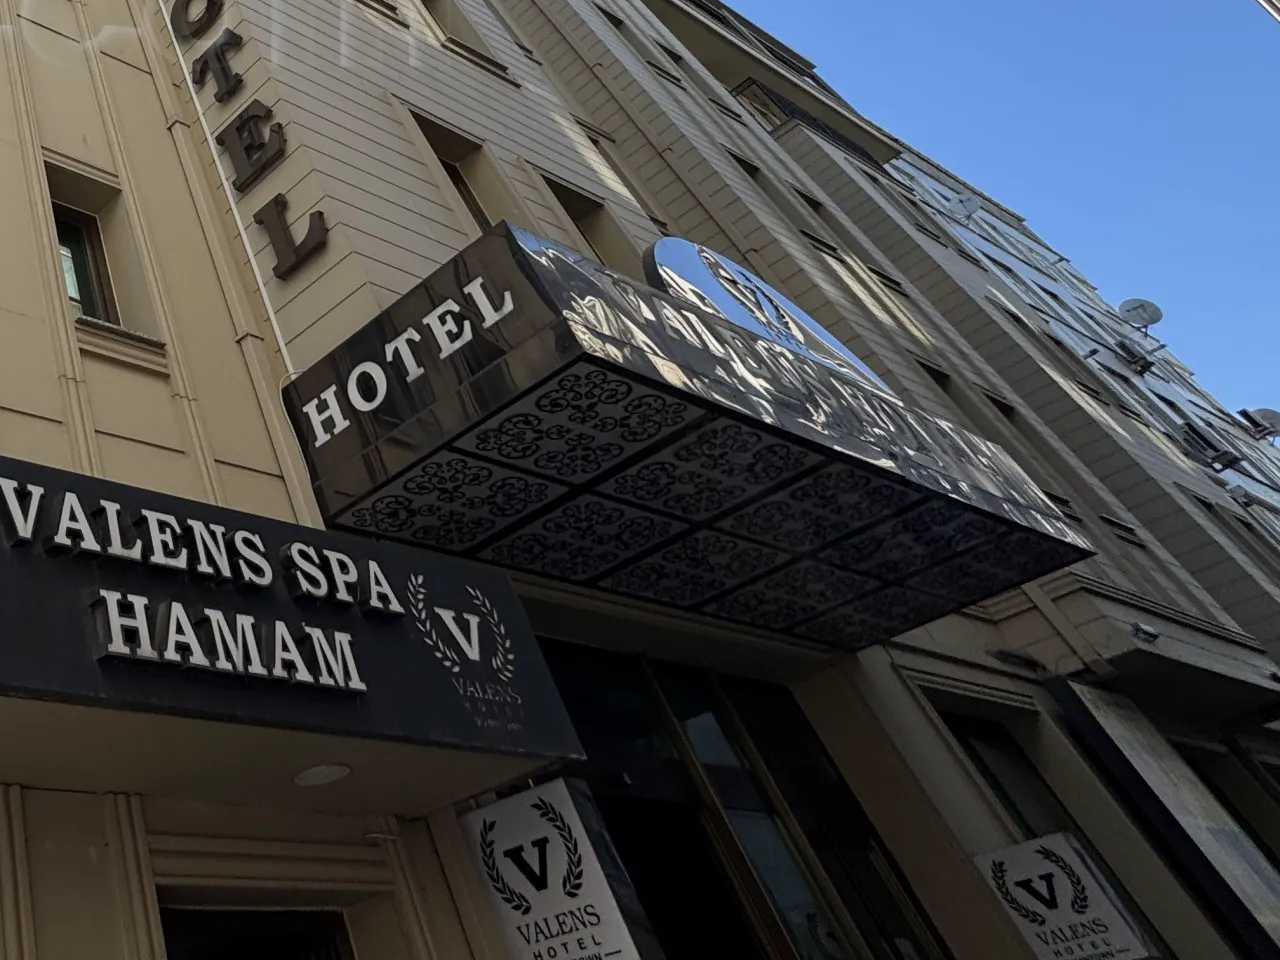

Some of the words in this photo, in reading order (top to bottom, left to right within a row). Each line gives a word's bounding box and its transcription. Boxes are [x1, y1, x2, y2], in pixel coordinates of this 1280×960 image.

[302, 276, 515, 448] HOTEL
[291, 542, 406, 613] SPA
[99, 588, 368, 690] HAMAM
[433, 606, 481, 662] V
[502, 836, 551, 893] V
[1014, 871, 1059, 911] V
[515, 903, 602, 946] VALENS
[532, 934, 603, 960] HOTEL
[1034, 916, 1110, 946] VALENS
